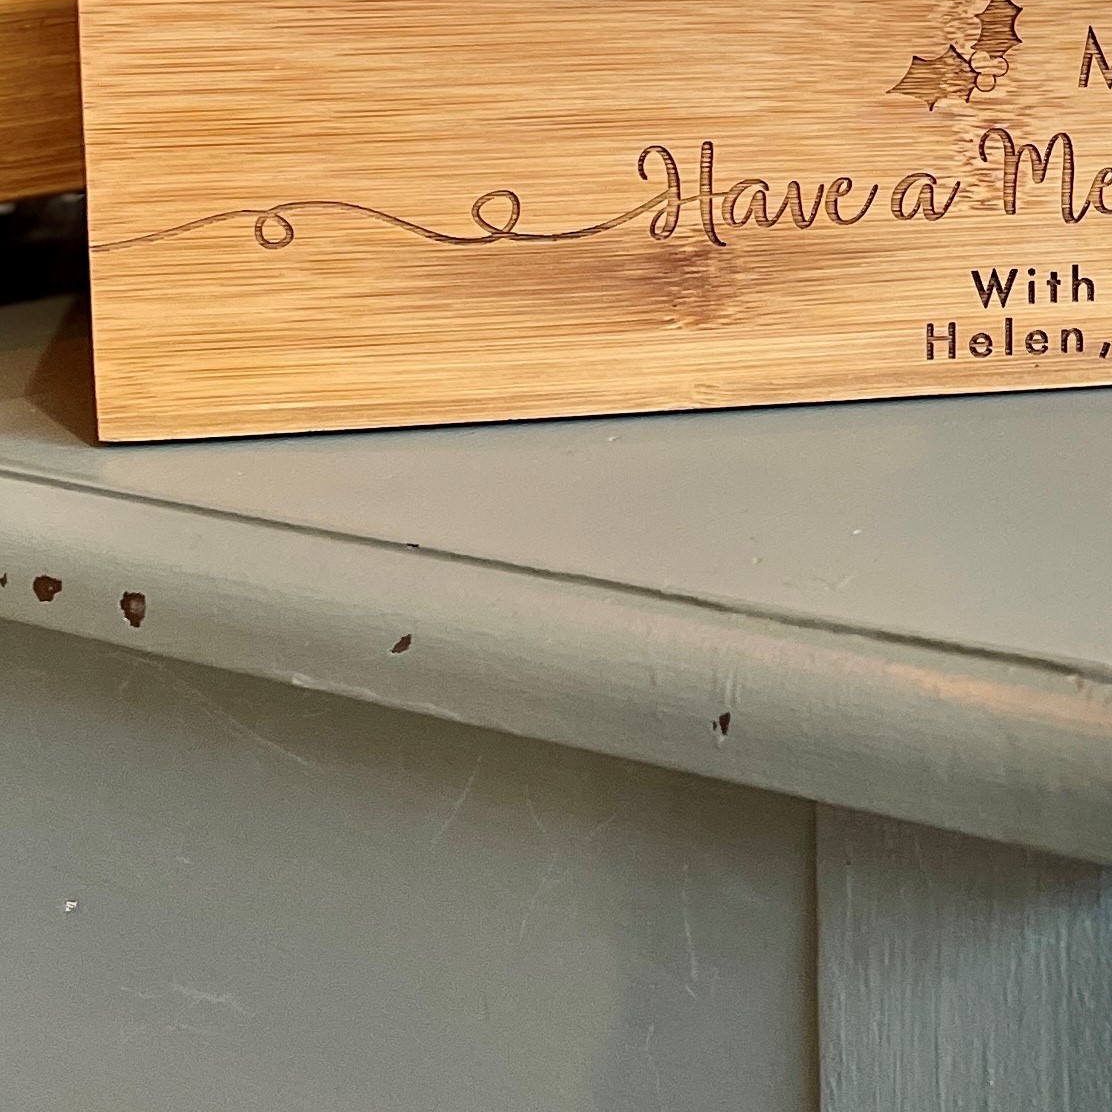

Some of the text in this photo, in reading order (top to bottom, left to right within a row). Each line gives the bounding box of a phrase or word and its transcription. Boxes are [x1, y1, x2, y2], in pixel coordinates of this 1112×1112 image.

[637, 140, 879, 247] Have
[891, 171, 962, 222] a
[970, 264, 1096, 310] With
